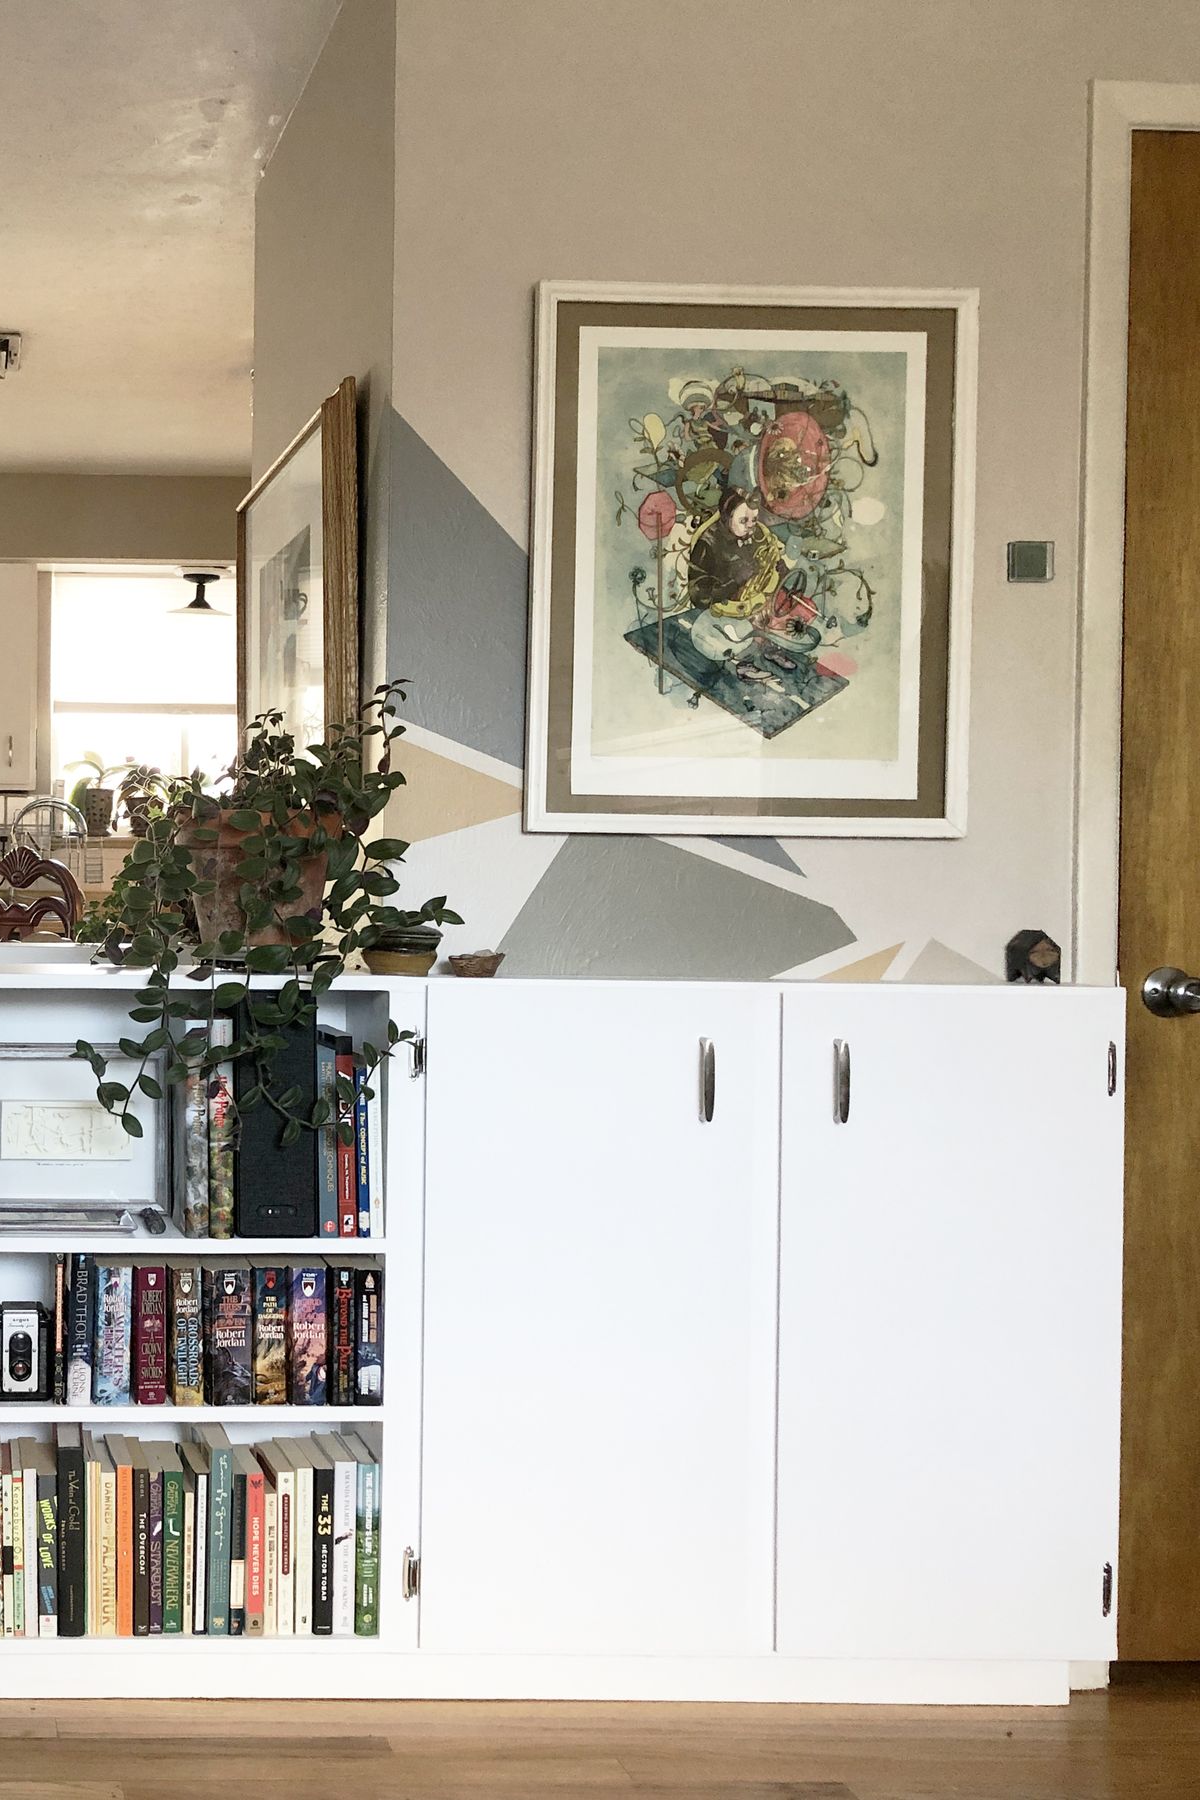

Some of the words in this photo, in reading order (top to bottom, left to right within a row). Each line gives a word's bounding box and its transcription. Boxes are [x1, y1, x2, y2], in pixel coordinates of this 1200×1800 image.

[359, 1112, 367, 1126] The
[76, 1270, 89, 1303] BRAD
[141, 1290, 163, 1302] ROBERT
[141, 1302, 164, 1315] JORDAN
[176, 1306, 198, 1314] Jordan
[336, 1287, 352, 1326] BEYOND
[75, 1305, 88, 1341] THOR
[177, 1318, 187, 1332] OF
[216, 1330, 246, 1338] Robert
[259, 1324, 284, 1332] Robert
[293, 1322, 325, 1330] Robert
[216, 1338, 246, 1348] Jordan
[259, 1331, 284, 1340] Jordan
[293, 1330, 325, 1339] Jordan
[103, 1326, 114, 1377] HEART
[113, 1313, 126, 1388] WINTER'S
[141, 1343, 162, 1355] CROWN
[188, 1317, 199, 1387] CROSSROADS
[336, 1345, 352, 1370] PALE
[148, 1355, 156, 1367] OF
[177, 1337, 187, 1386] TWILIGHT
[141, 1367, 163, 1379] SWORDS
[68, 1480, 80, 1497] Vein
[365, 1472, 373, 1488] THE
[104, 1482, 113, 1524] DAMNED
[150, 1483, 159, 1517] GAIMAN
[166, 1481, 178, 1515] GAIMAN
[321, 1493, 329, 1512] THE
[40, 1498, 57, 1530] WORKS
[68, 1505, 80, 1530] Gold
[139, 1512, 147, 1529] THE
[365, 1489, 373, 1536] SHEPHERD'S
[252, 1517, 260, 1541] HOPE
[317, 1514, 332, 1536] 33
[42, 1533, 54, 1544] OF
[365, 1537, 373, 1554] LIFE
[39, 1547, 54, 1569] LOVE
[139, 1532, 147, 1576] OVERCOAT
[102, 1536, 114, 1626] PALAHNIUK
[150, 1541, 161, 1606] STARDUST
[166, 1539, 179, 1610] NEVERWHERE
